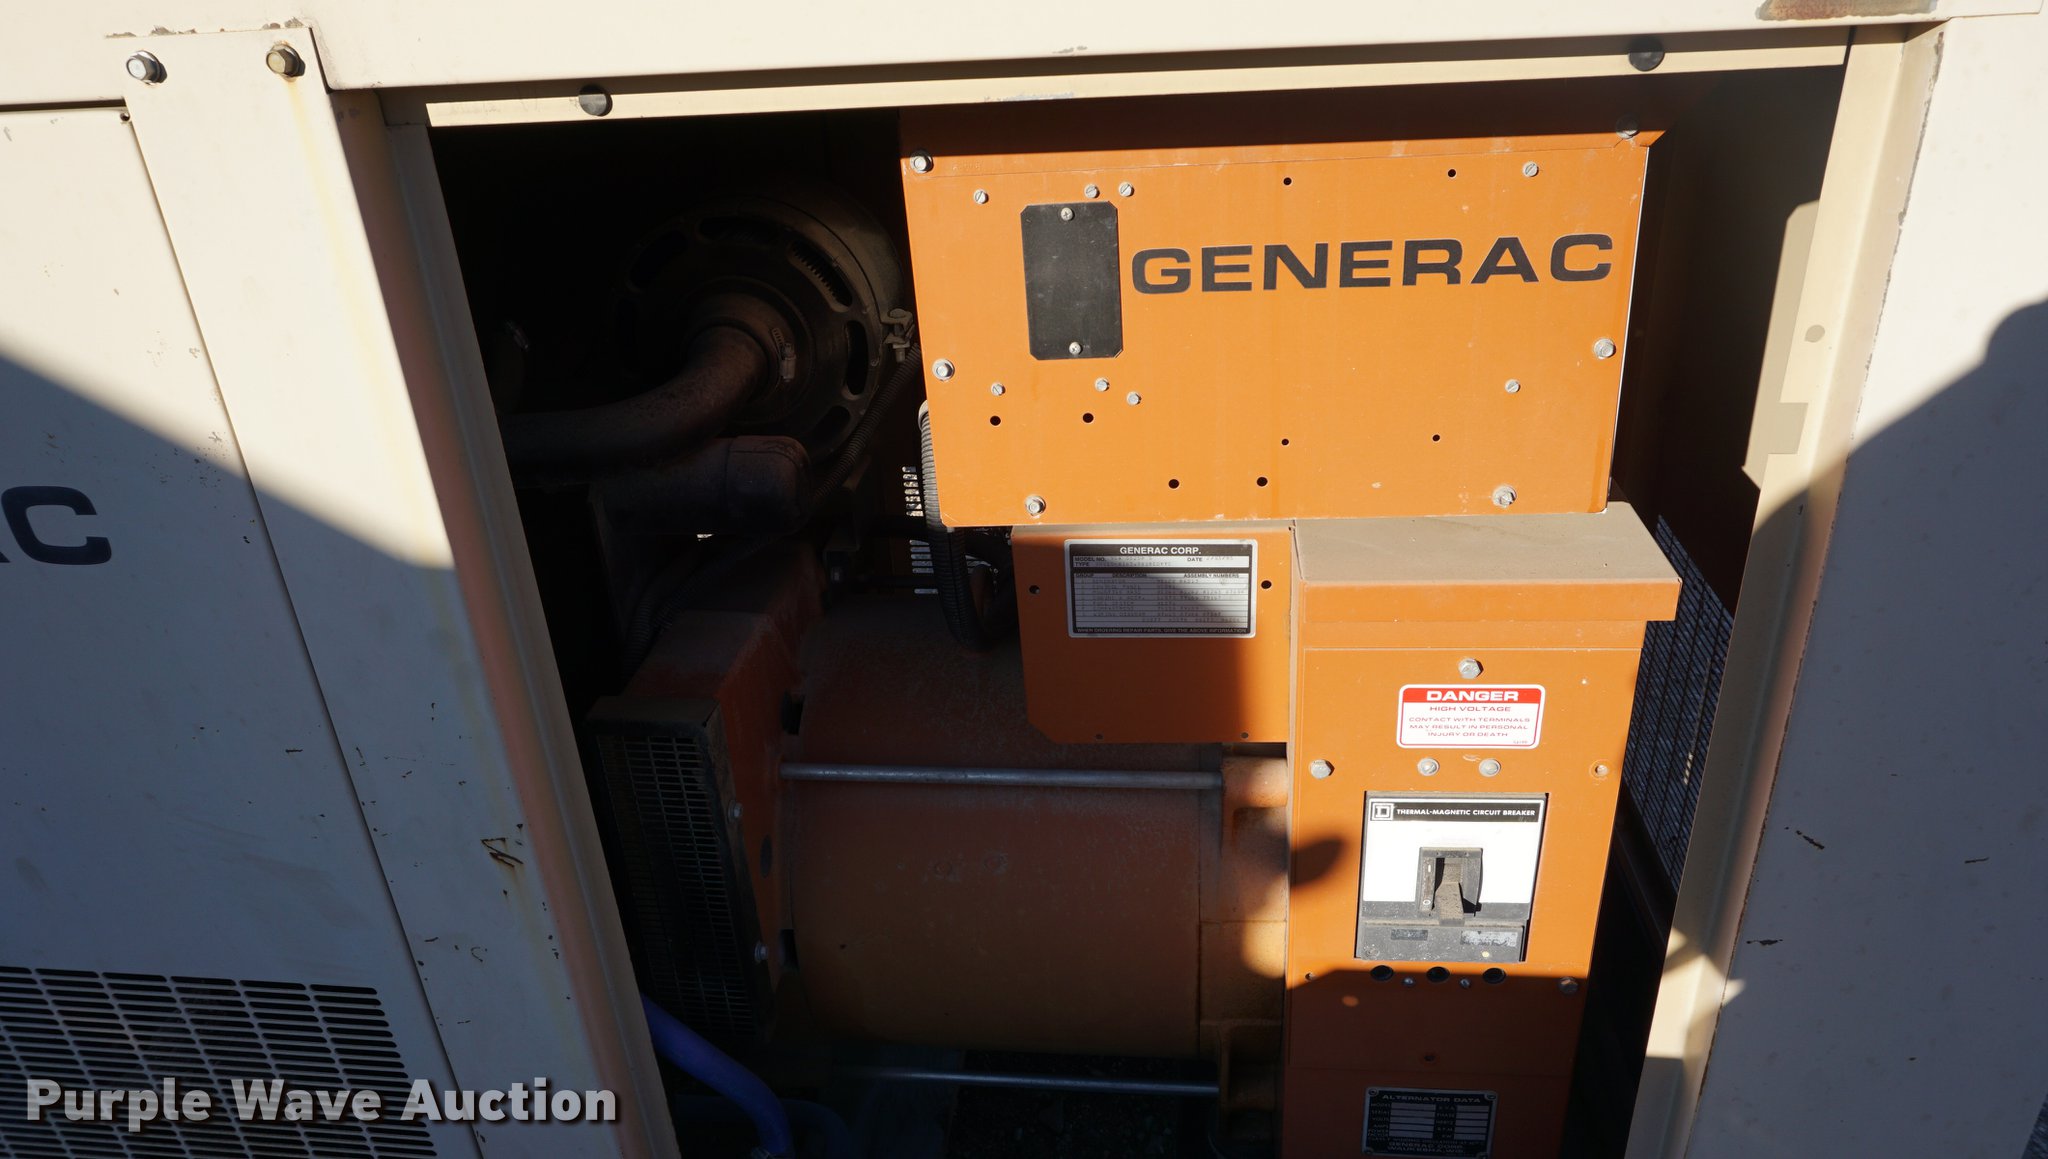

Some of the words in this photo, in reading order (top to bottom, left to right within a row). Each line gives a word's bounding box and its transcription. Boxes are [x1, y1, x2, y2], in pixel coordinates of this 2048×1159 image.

[1131, 233, 1613, 295] GENERAC
[0, 485, 112, 566] C
[1119, 546, 1168, 555] GENERAC
[1170, 546, 1202, 555] CORP.
[1426, 690, 1519, 702] DANGER
[1396, 808, 1470, 816] THERMAL-MAGNETIC
[1382, 1094, 1451, 1102] ALTERNATOR
